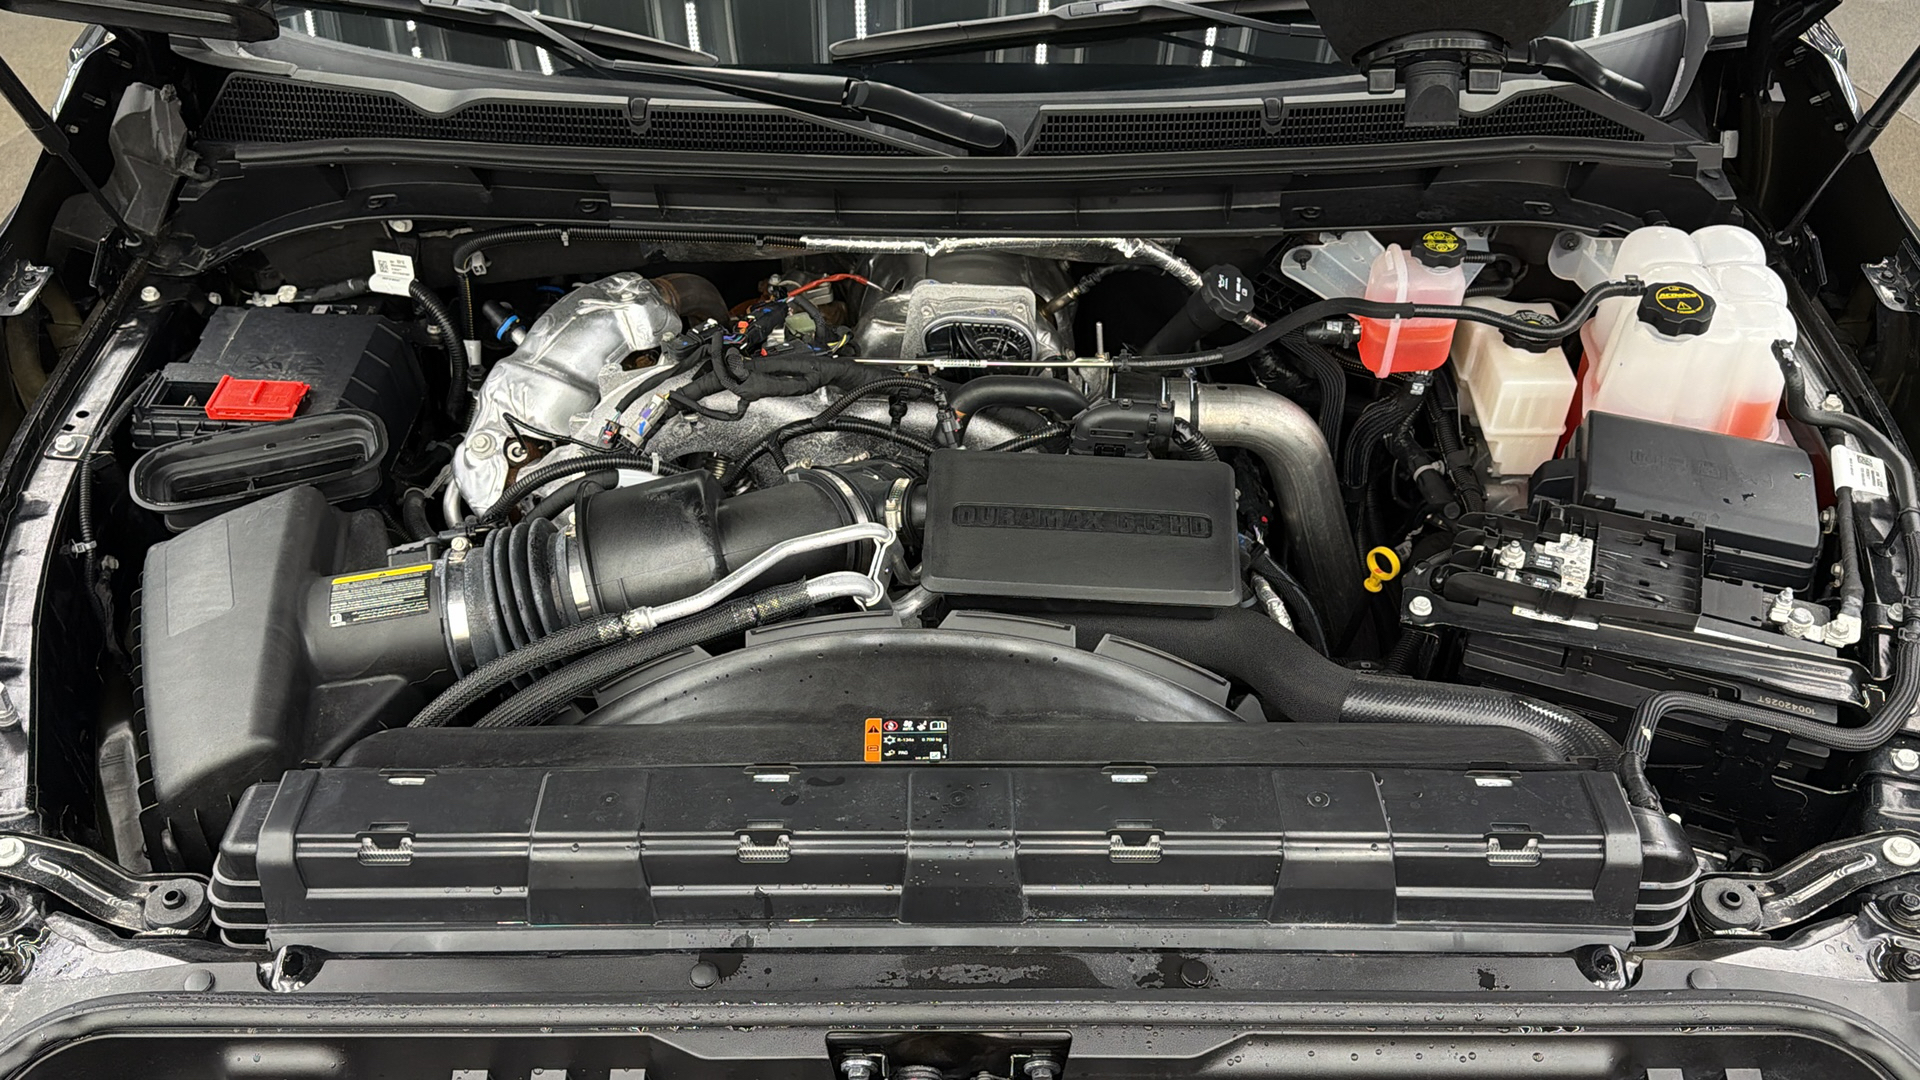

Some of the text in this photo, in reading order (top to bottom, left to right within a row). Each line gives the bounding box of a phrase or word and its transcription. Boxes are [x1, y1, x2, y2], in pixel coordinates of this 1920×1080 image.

[958, 506, 1209, 538] DURAMAX 6.6 HD
[1757, 695, 1816, 715] 10042025T
